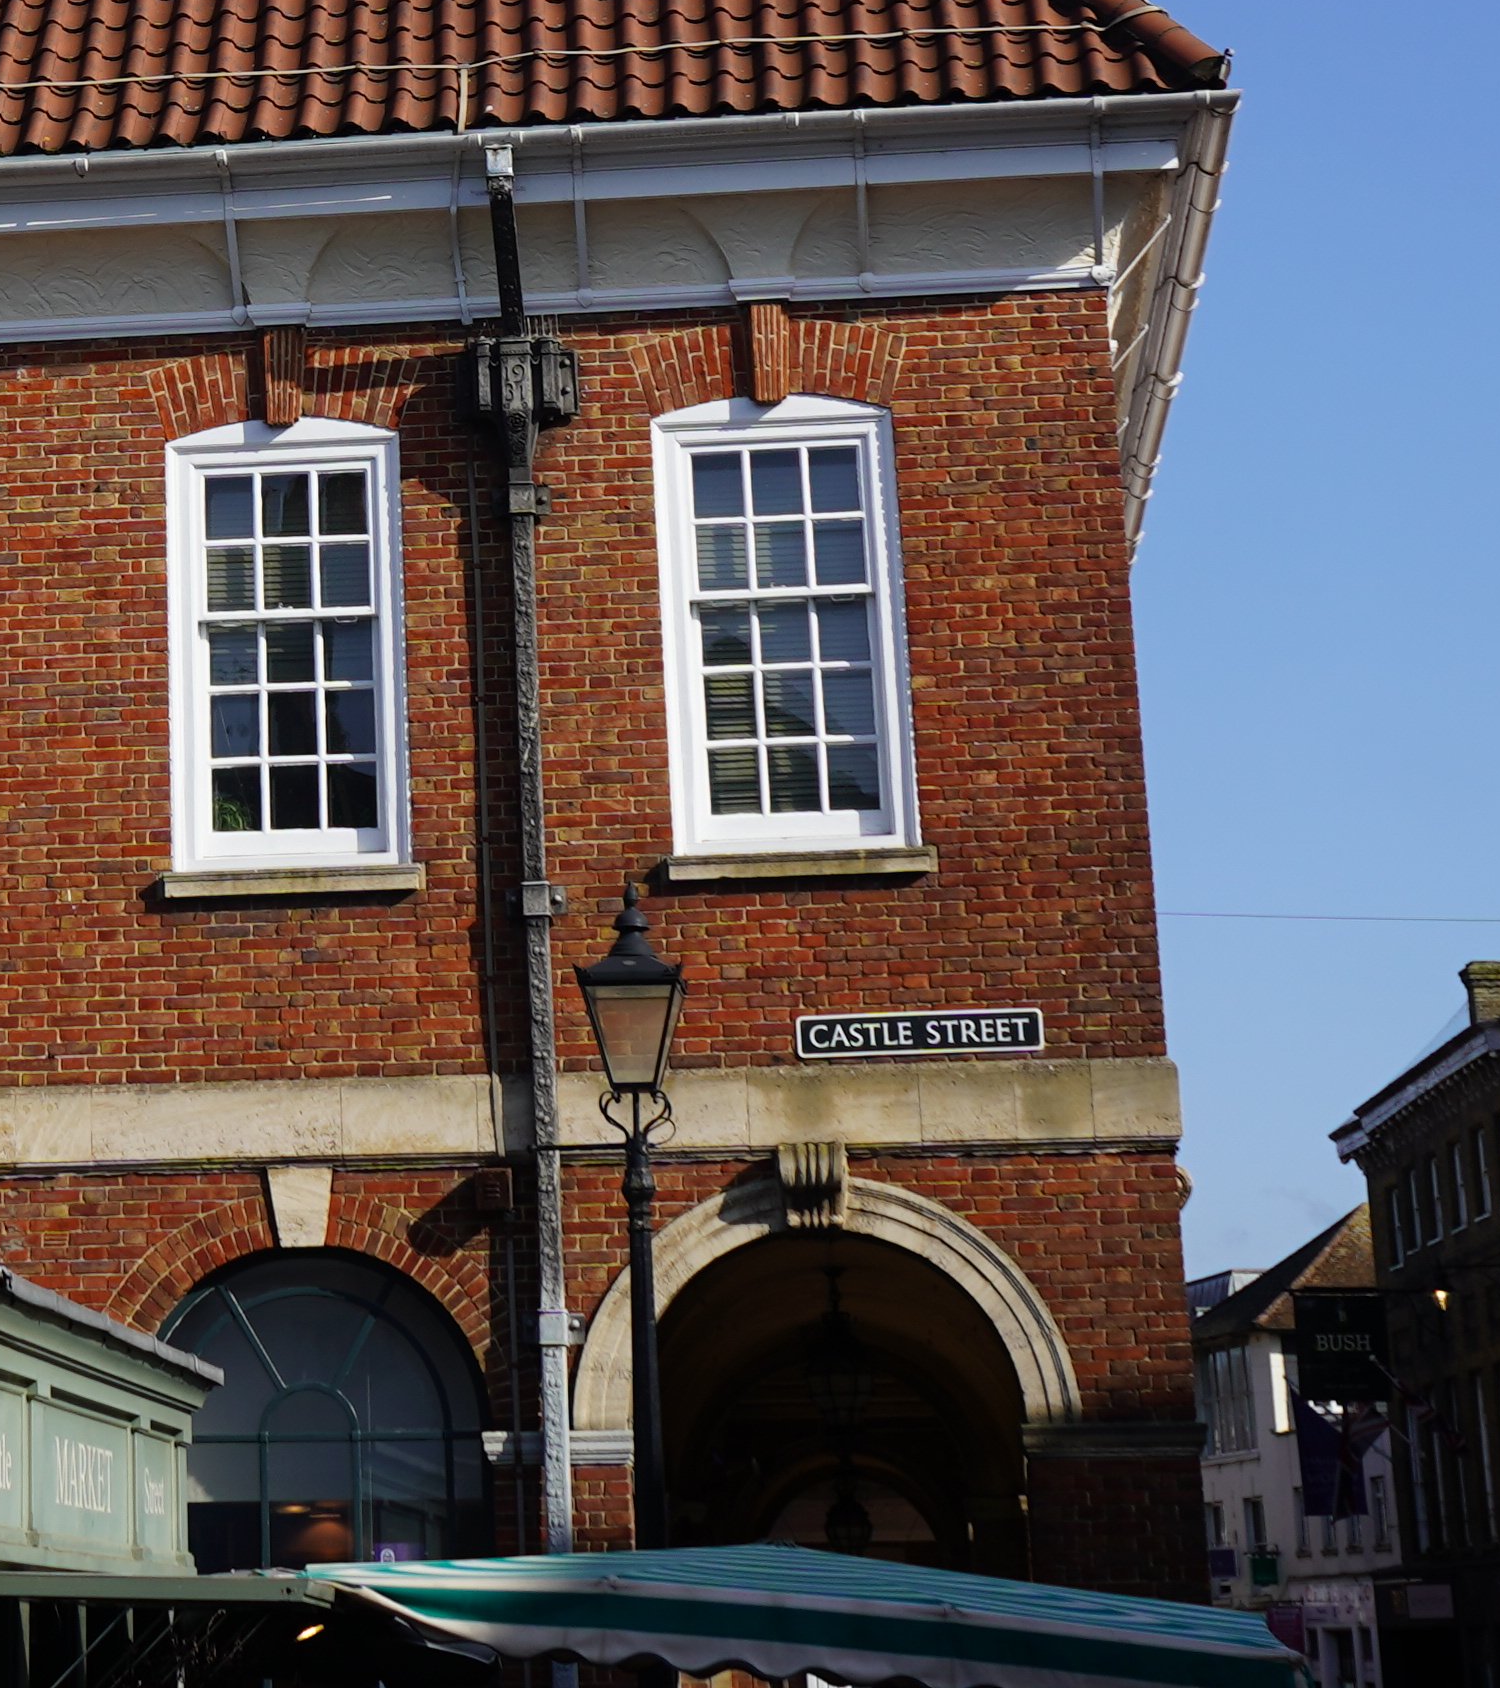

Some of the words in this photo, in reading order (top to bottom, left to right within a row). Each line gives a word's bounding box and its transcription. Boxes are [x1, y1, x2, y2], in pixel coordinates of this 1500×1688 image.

[808, 1021, 913, 1048] CASTLE
[926, 1017, 1030, 1044] STREET
[1315, 1334, 1374, 1352] BUSH
[55, 1435, 113, 1514] MARKET
[144, 1467, 166, 1515] Street
